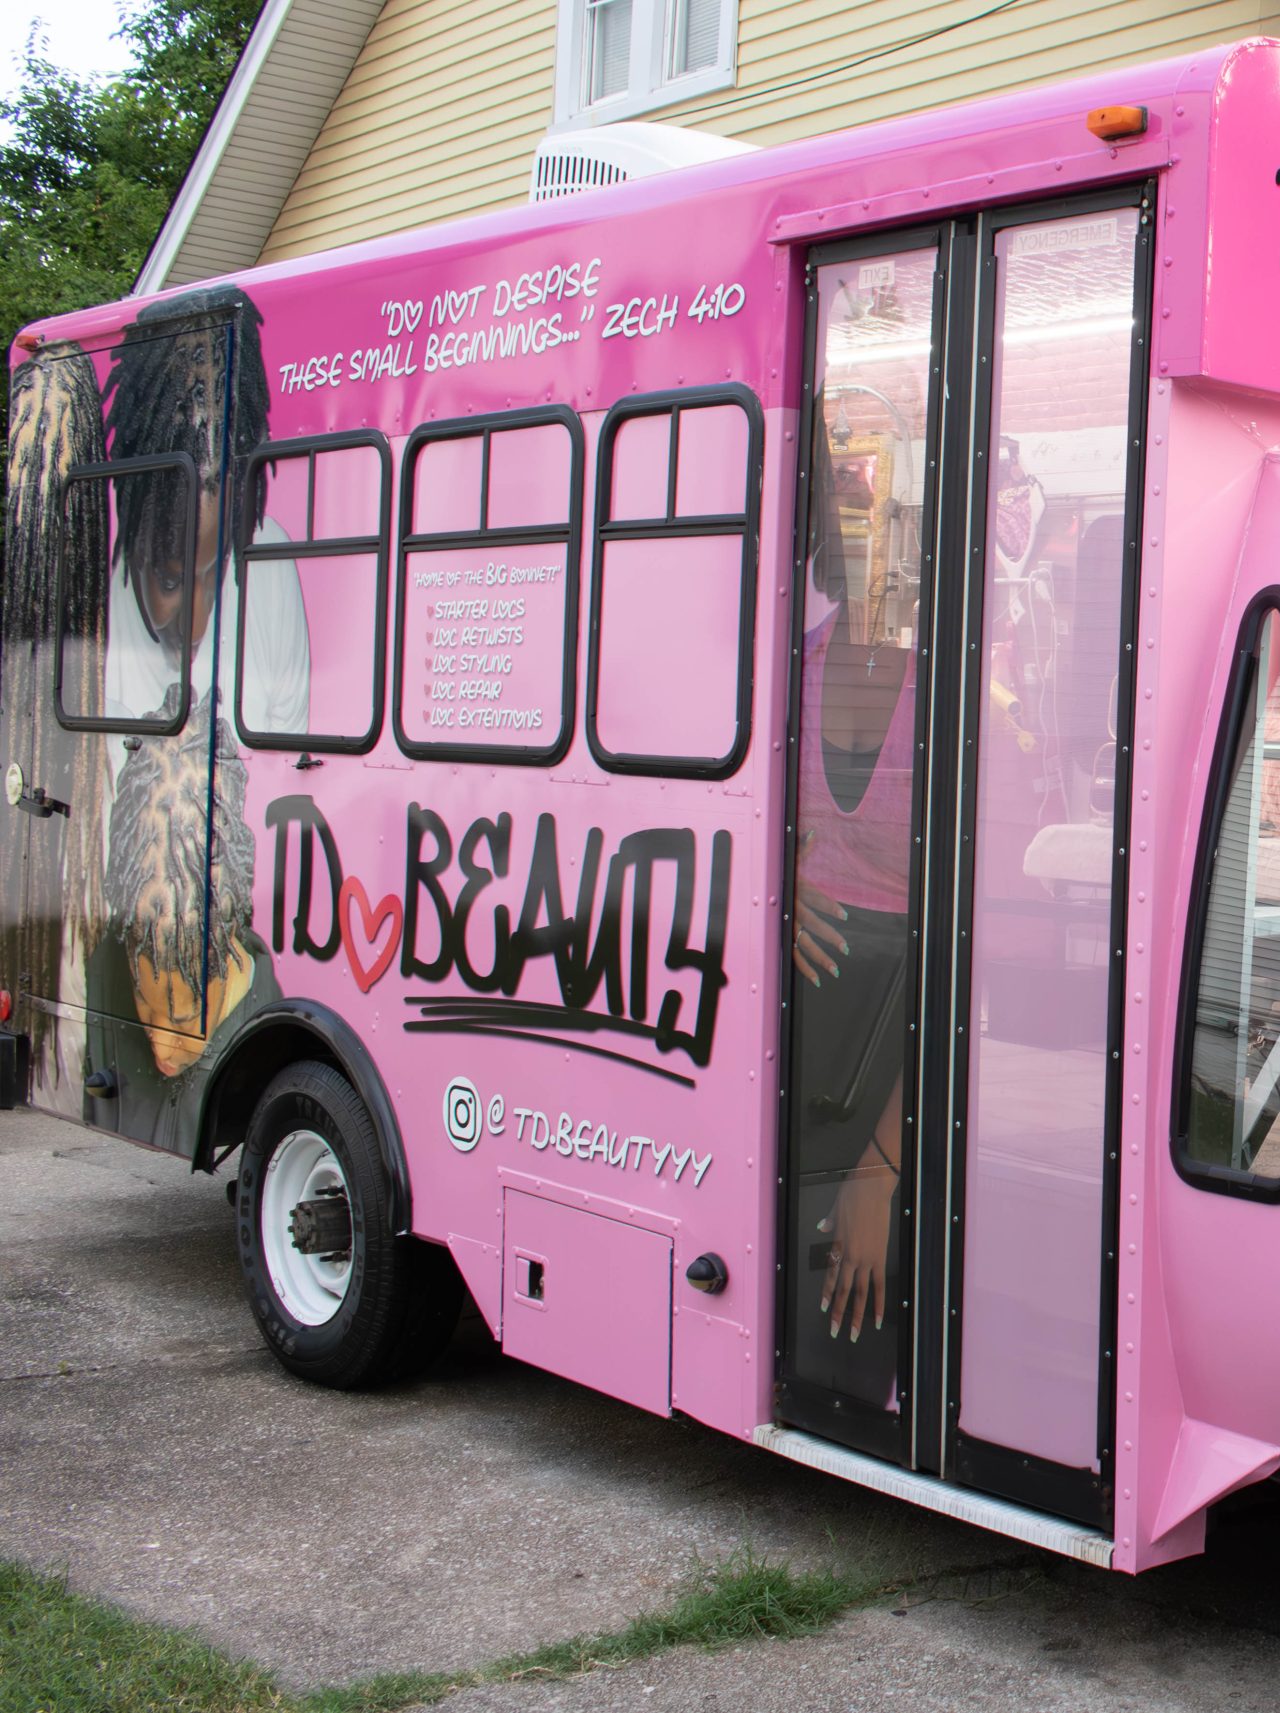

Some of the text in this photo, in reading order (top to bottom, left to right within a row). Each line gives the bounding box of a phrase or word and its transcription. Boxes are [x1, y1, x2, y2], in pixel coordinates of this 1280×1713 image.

[429, 285, 485, 328] NOT
[494, 258, 603, 317] DESPISE
[280, 356, 343, 395] THESE
[348, 340, 418, 384] SMALL
[601, 295, 679, 339] ZECH
[687, 282, 746, 325] 4:10
[464, 569, 485, 585] THE
[486, 562, 508, 586] BIG
[434, 598, 526, 620] STARTER LOCS
[433, 626, 524, 648] LOC RETWISTS
[432, 654, 513, 674] LOC STYLING
[431, 680, 503, 701] LOC REPAIR
[430, 707, 543, 729] LOC EXTENTIONS
[400, 801, 732, 1068] BEAUTY
[513, 1107, 713, 1187] TD.BEAUTYYY
